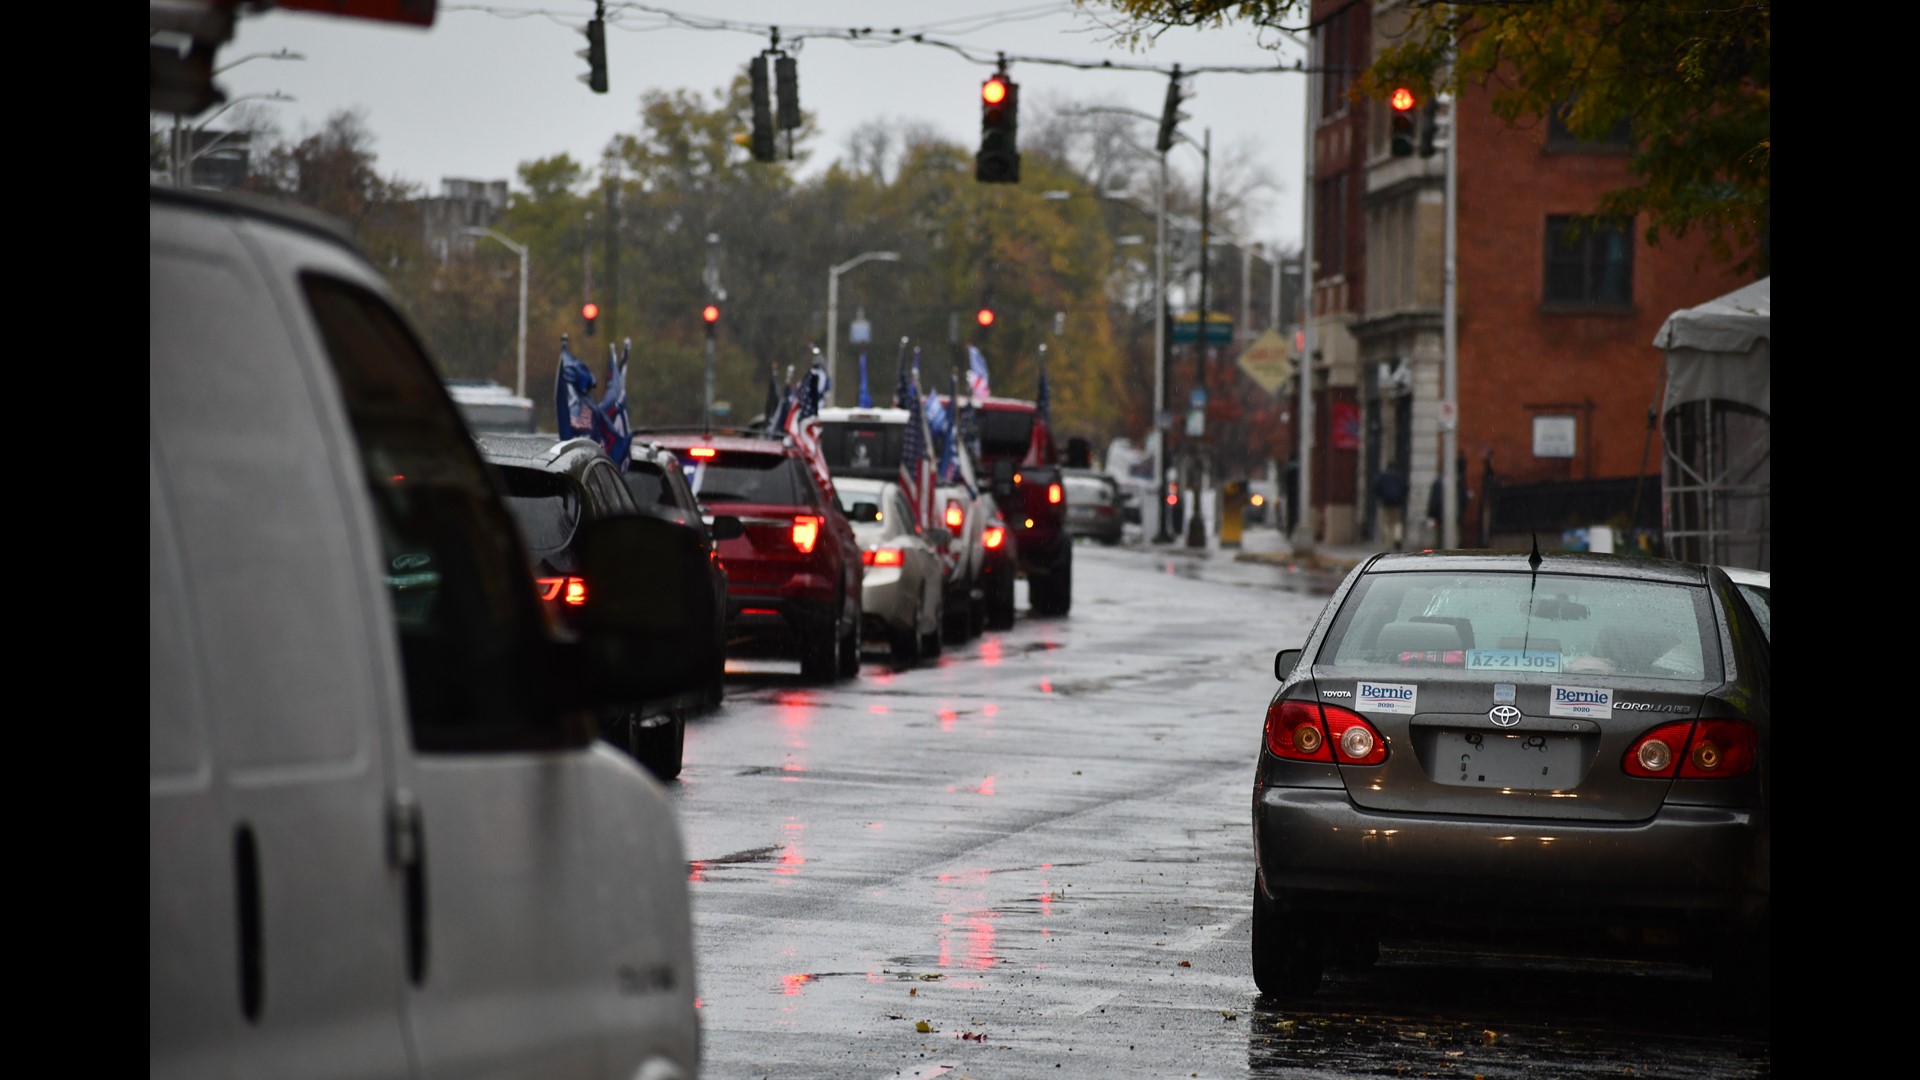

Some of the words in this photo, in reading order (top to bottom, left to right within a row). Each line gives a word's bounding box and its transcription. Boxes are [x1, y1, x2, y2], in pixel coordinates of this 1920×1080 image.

[1472, 655, 1556, 668] AZ-21305
[1322, 690, 1352, 698] TOYOTA
[1361, 684, 1413, 700] Bernie
[1555, 688, 1608, 704] Bernie
